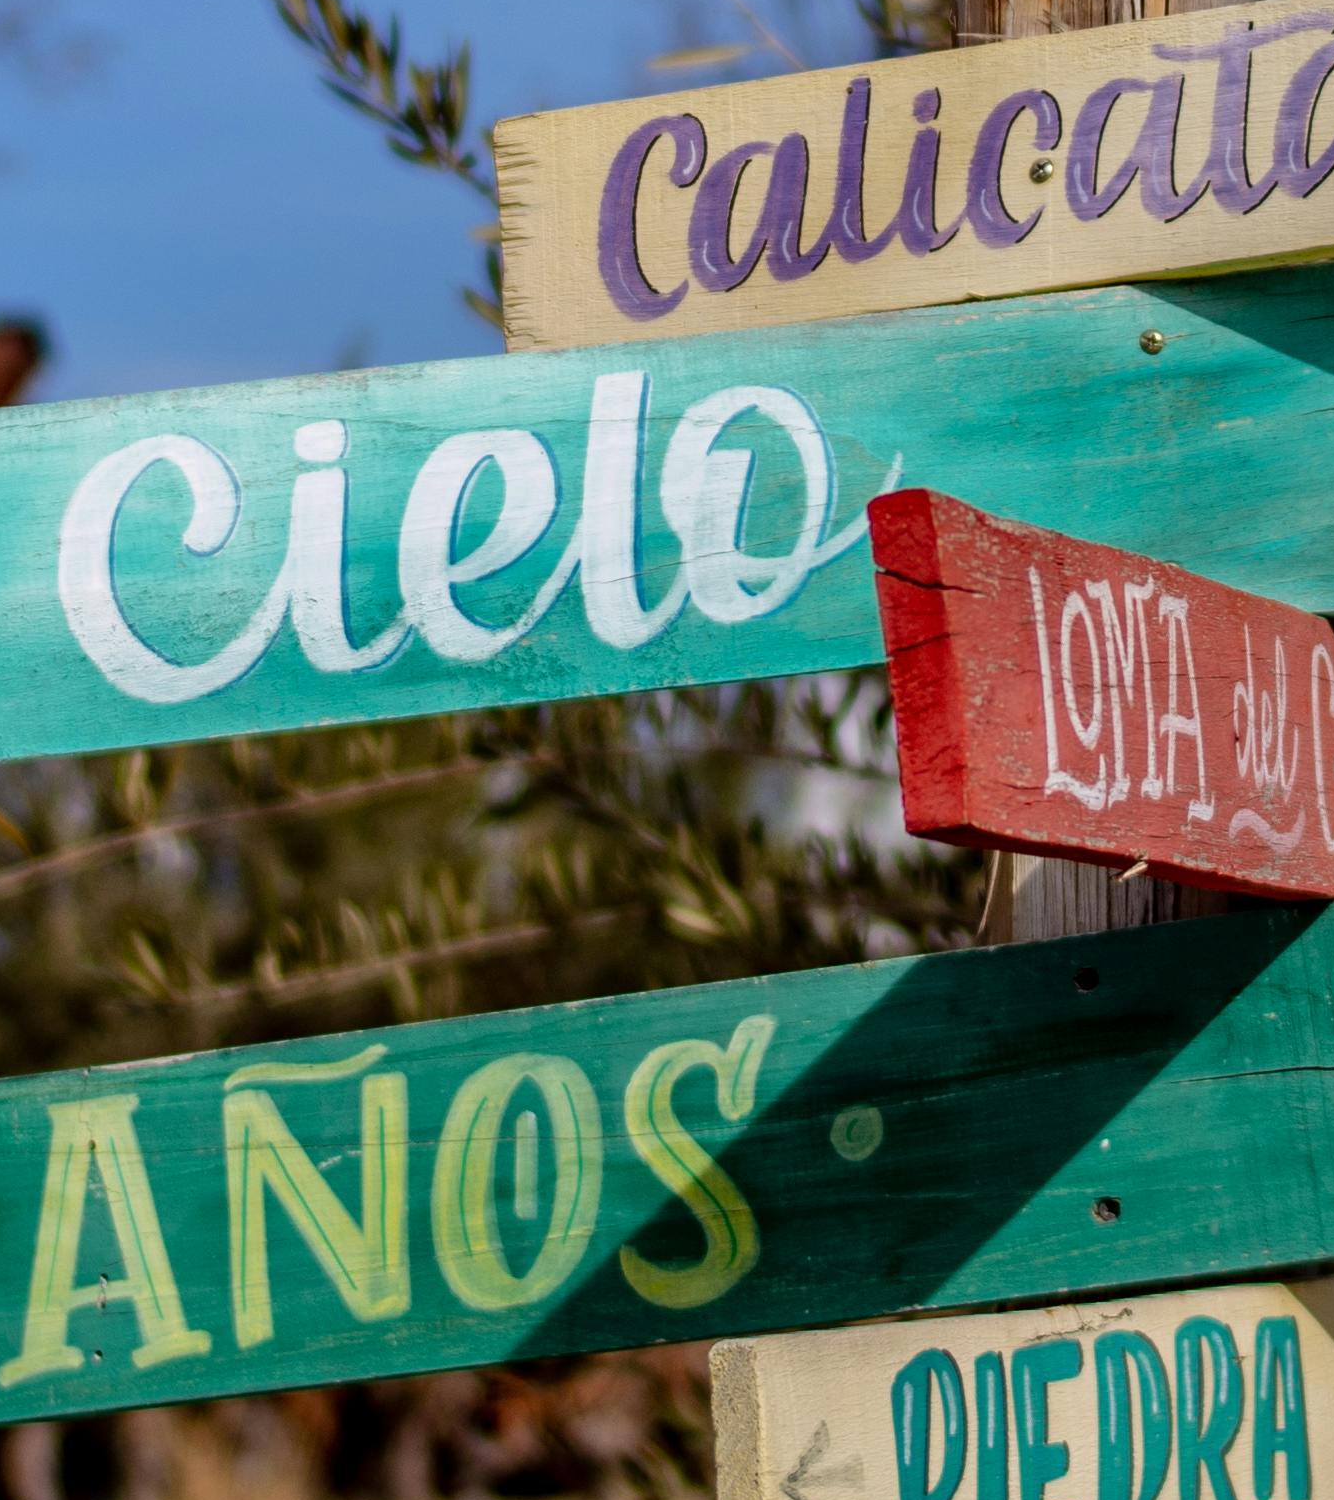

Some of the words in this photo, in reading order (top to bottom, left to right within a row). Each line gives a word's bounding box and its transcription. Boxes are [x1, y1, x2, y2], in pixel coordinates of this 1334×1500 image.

[58, 369, 902, 703] Cielo
[1028, 565, 1216, 822] LOMA
[1232, 623, 1300, 803] del
